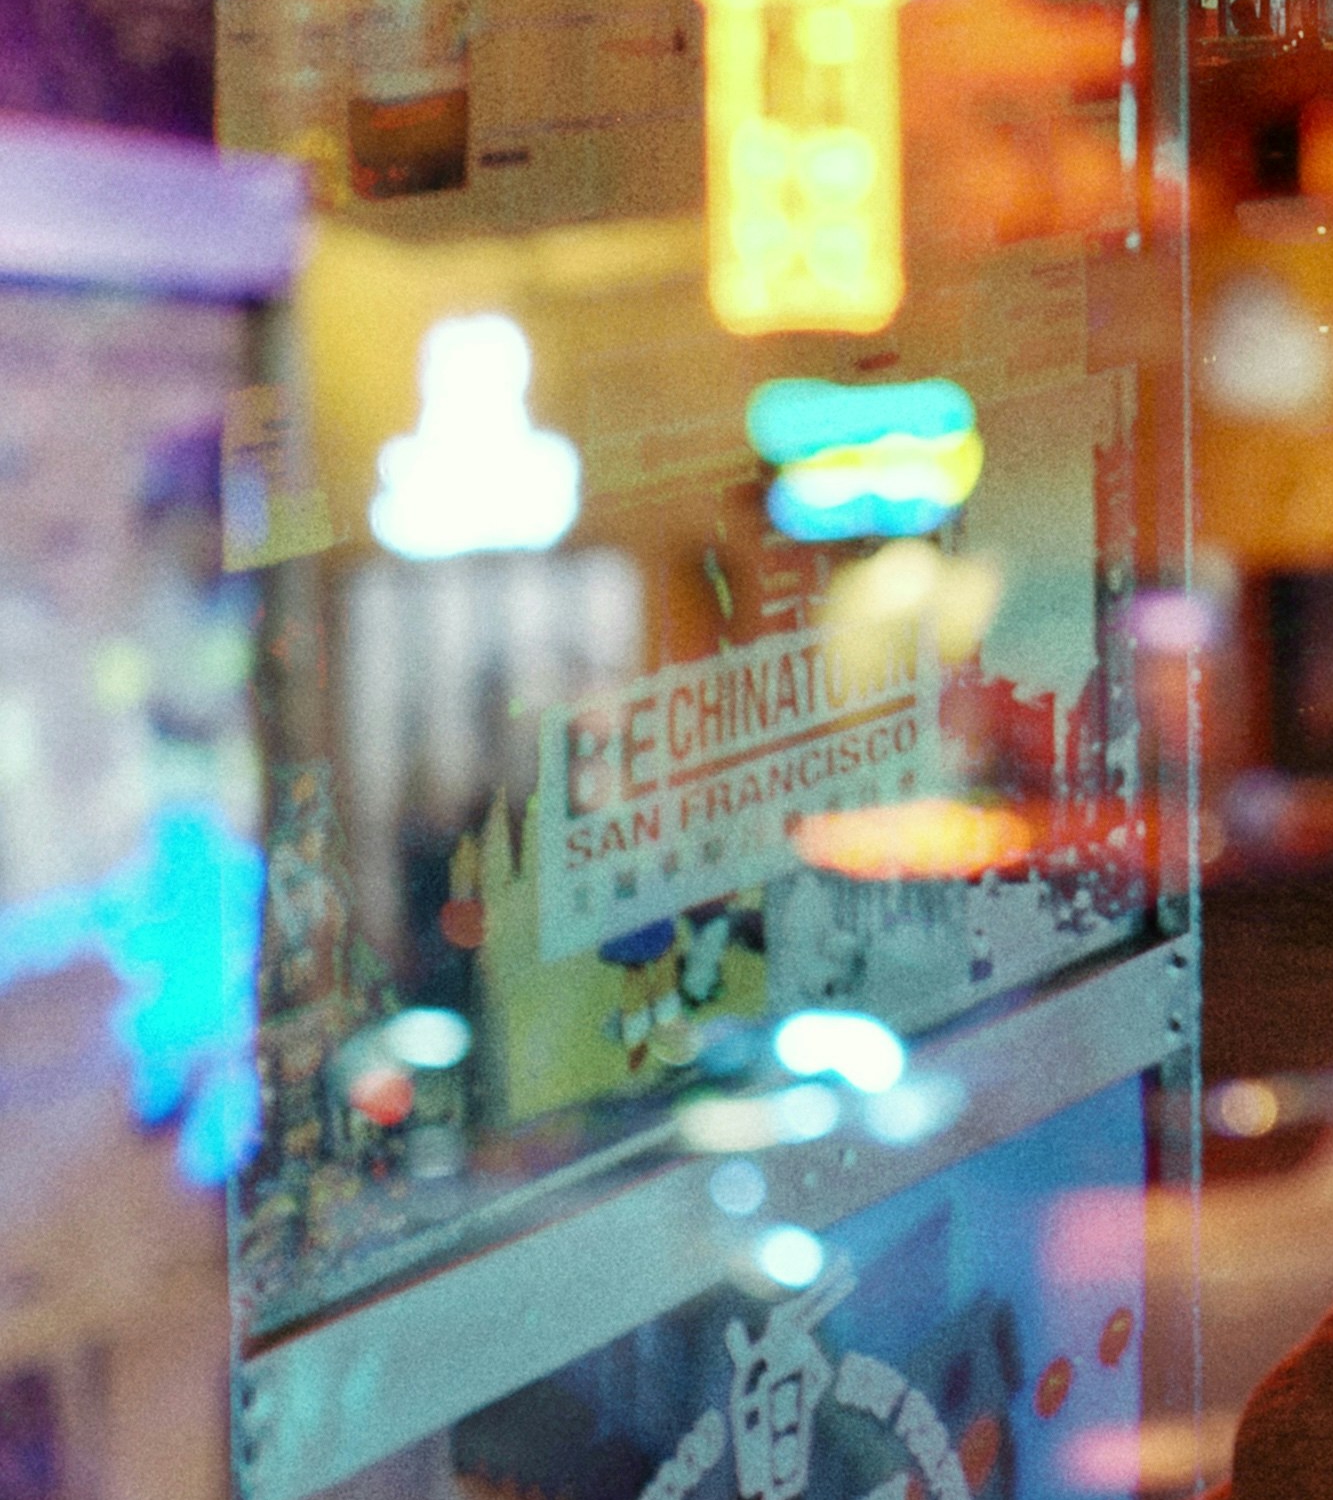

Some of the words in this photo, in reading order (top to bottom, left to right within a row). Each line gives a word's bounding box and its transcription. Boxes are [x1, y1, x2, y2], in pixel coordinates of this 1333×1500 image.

[565, 804, 661, 871] SAN
[680, 717, 918, 832] FRANCISCO
[566, 693, 659, 820] BE
